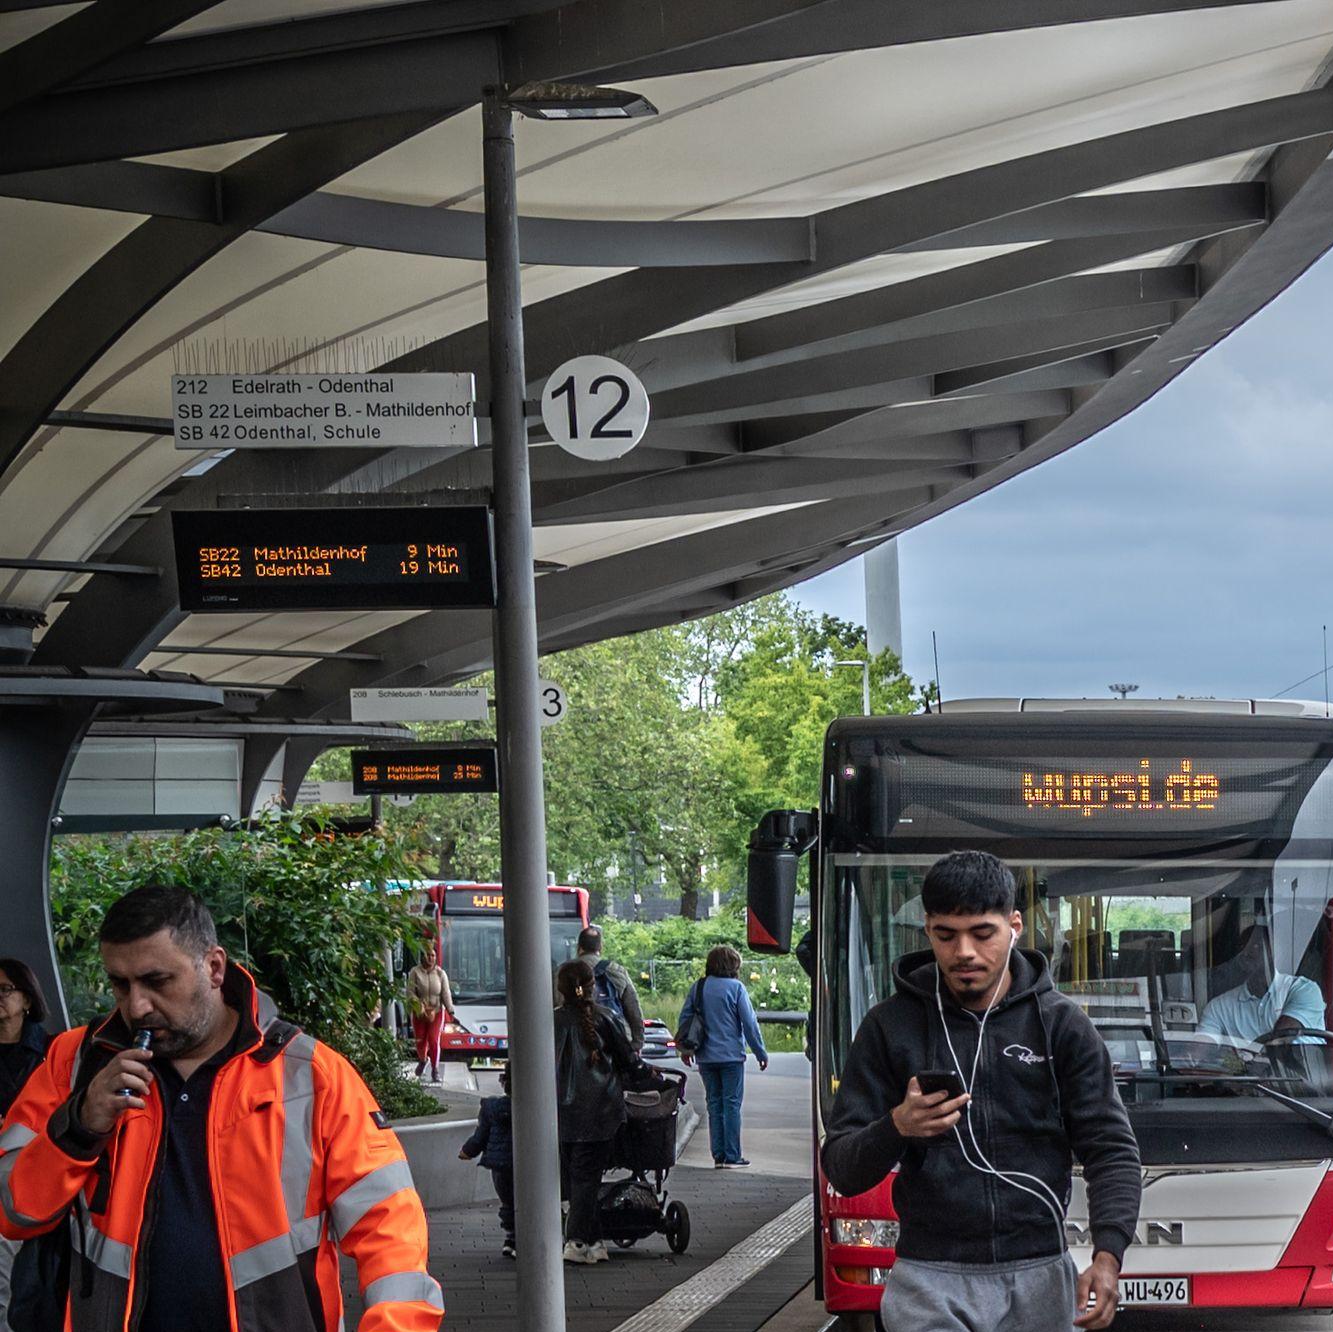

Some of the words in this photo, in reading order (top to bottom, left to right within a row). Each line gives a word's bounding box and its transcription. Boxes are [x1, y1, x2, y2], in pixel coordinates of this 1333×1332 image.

[176, 380, 208, 395] 212
[232, 379, 301, 394] Edelrath
[318, 378, 394, 394] Odenthal
[178, 404, 203, 419] SB
[209, 403, 229, 419] 22
[233, 403, 330, 418] Leimbacher
[335, 403, 351, 418] B.
[366, 401, 471, 417] Mathildenhof
[551, 374, 633, 439] 12
[180, 425, 203, 440] SB
[210, 424, 231, 440] 42
[234, 424, 316, 440] Odenthal,
[323, 425, 381, 440] Schule
[200, 548, 240, 562] SB22
[254, 545, 368, 563] Mathildenhof
[407, 544, 417, 558] 9
[427, 544, 458, 558] Min
[200, 564, 241, 578] SB42
[255, 563, 332, 577] Odenthal
[400, 561, 419, 575] 19
[428, 561, 459, 575] Min
[542, 688, 562, 717] 3
[1022, 758, 1219, 817] wupsi.de
[1065, 1221, 1184, 1246] MN
